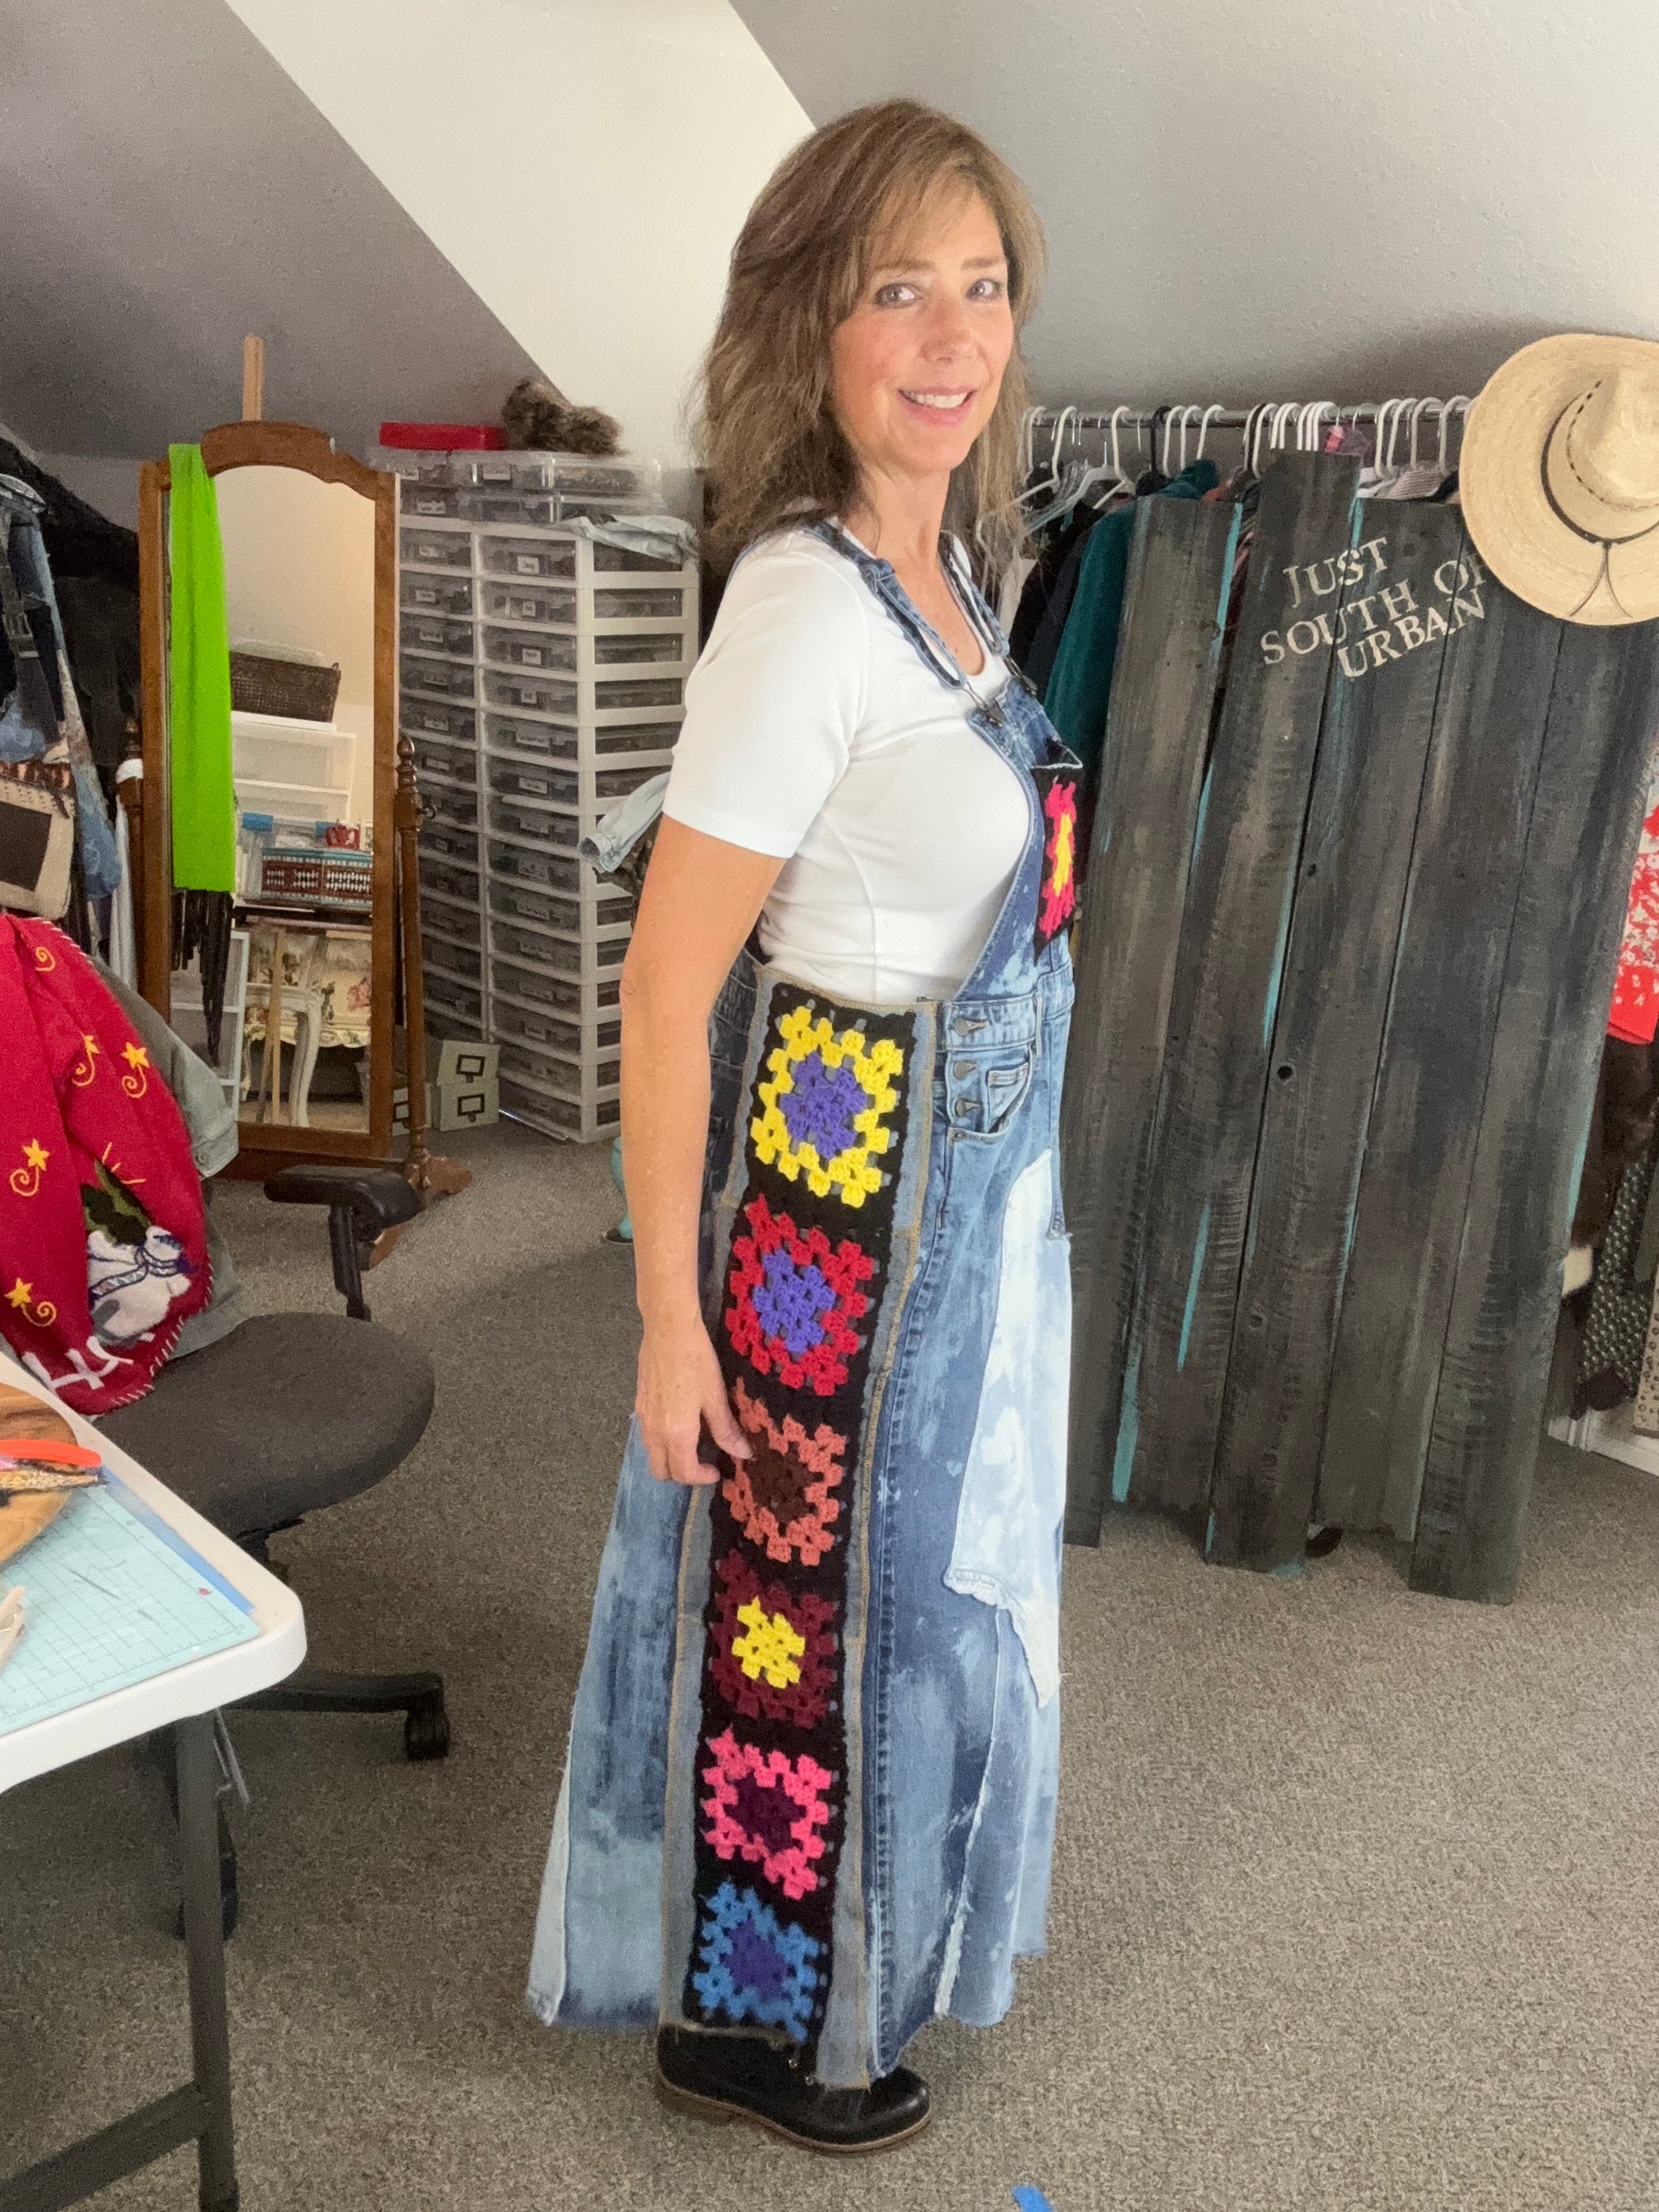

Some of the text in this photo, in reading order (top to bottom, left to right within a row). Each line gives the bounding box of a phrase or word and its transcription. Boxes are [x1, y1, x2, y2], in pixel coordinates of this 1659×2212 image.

[1283, 537, 1388, 608] JUST
[1260, 578, 1419, 665] SOUTH
[1338, 588, 1485, 678] URBAN
